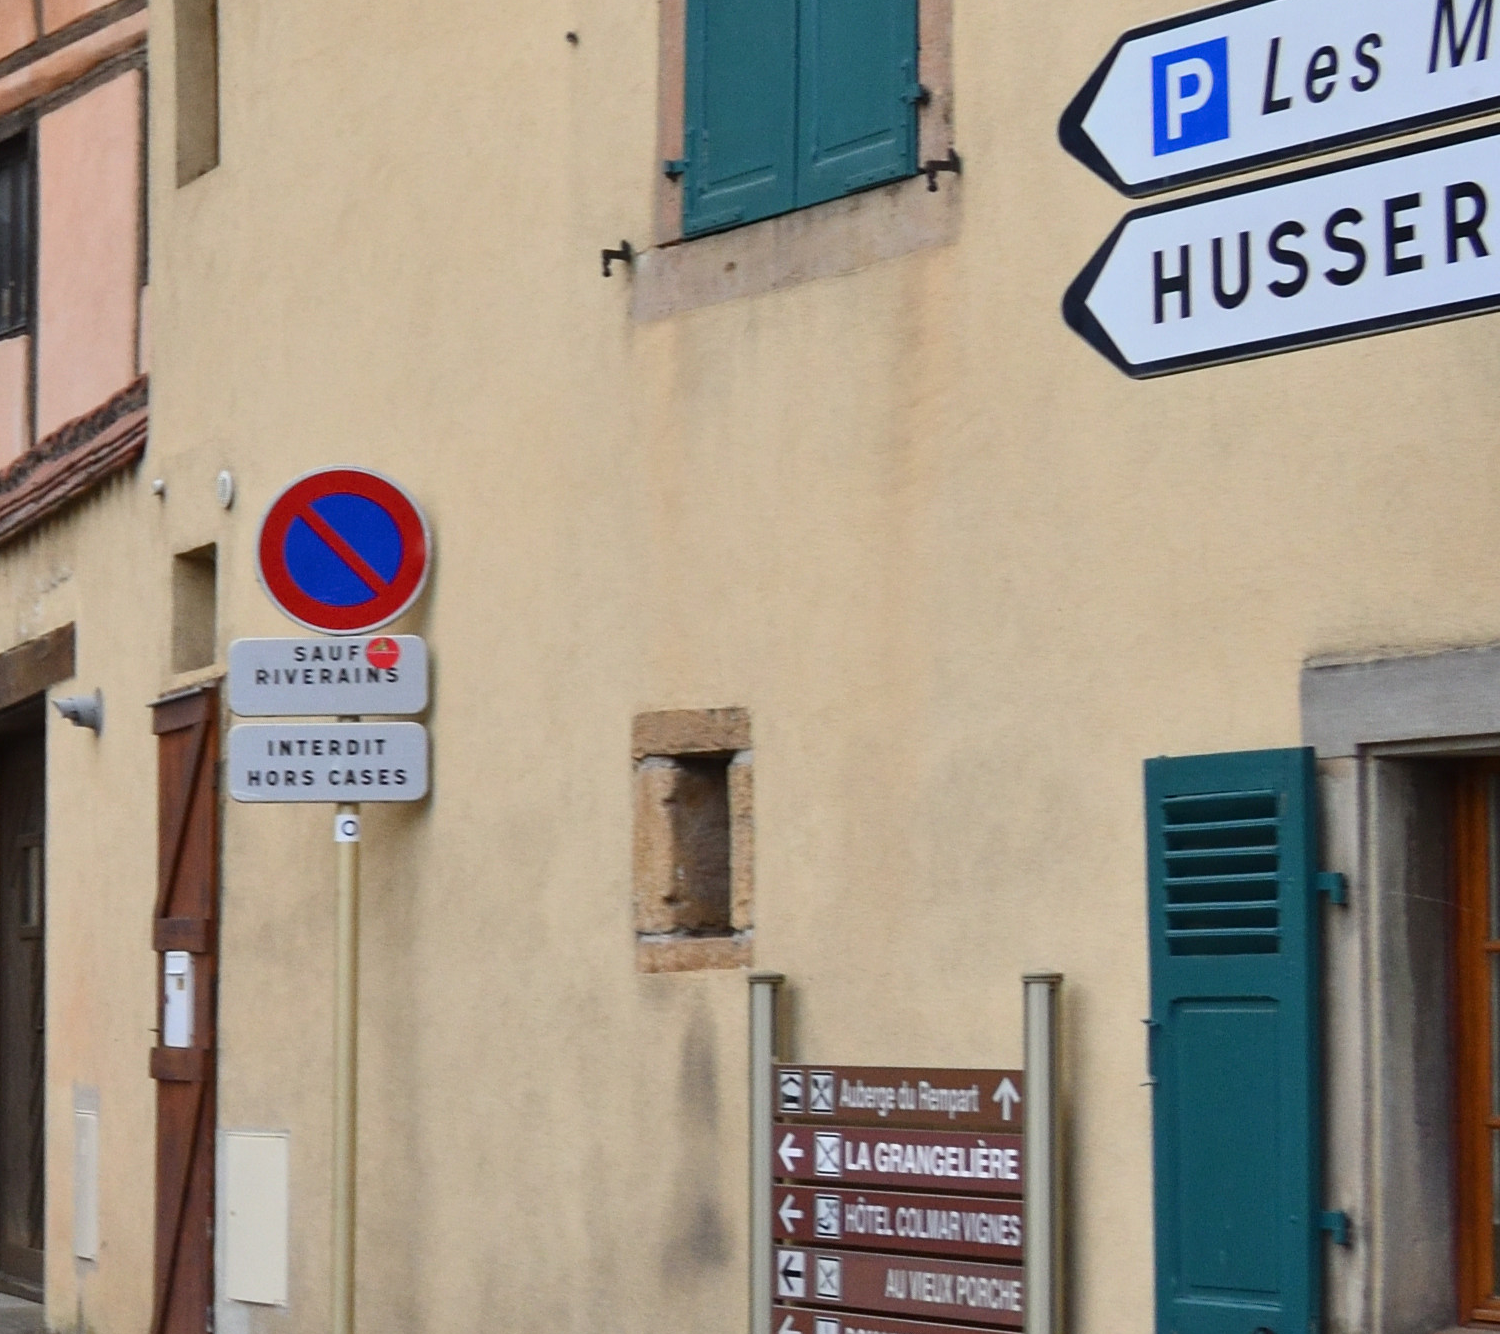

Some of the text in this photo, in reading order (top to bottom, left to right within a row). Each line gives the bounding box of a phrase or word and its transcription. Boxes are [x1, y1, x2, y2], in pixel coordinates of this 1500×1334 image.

[1166, 58, 1214, 139] P
[1261, 33, 1383, 115] Les
[1152, 181, 1489, 324] HUSSER
[294, 645, 361, 662] SAUF
[255, 667, 399, 685] RIVERAINS
[268, 739, 386, 756] INTERDIT
[247, 769, 407, 787] HORS CASES
[839, 1078, 980, 1119] Auberge du Rempart
[845, 1139, 1019, 1180] LA GRANGELIÈRE
[845, 1196, 1022, 1246] HÔTEL COLMAR VIGNES
[885, 1268, 1022, 1311] AU VIEUX PORCHE
